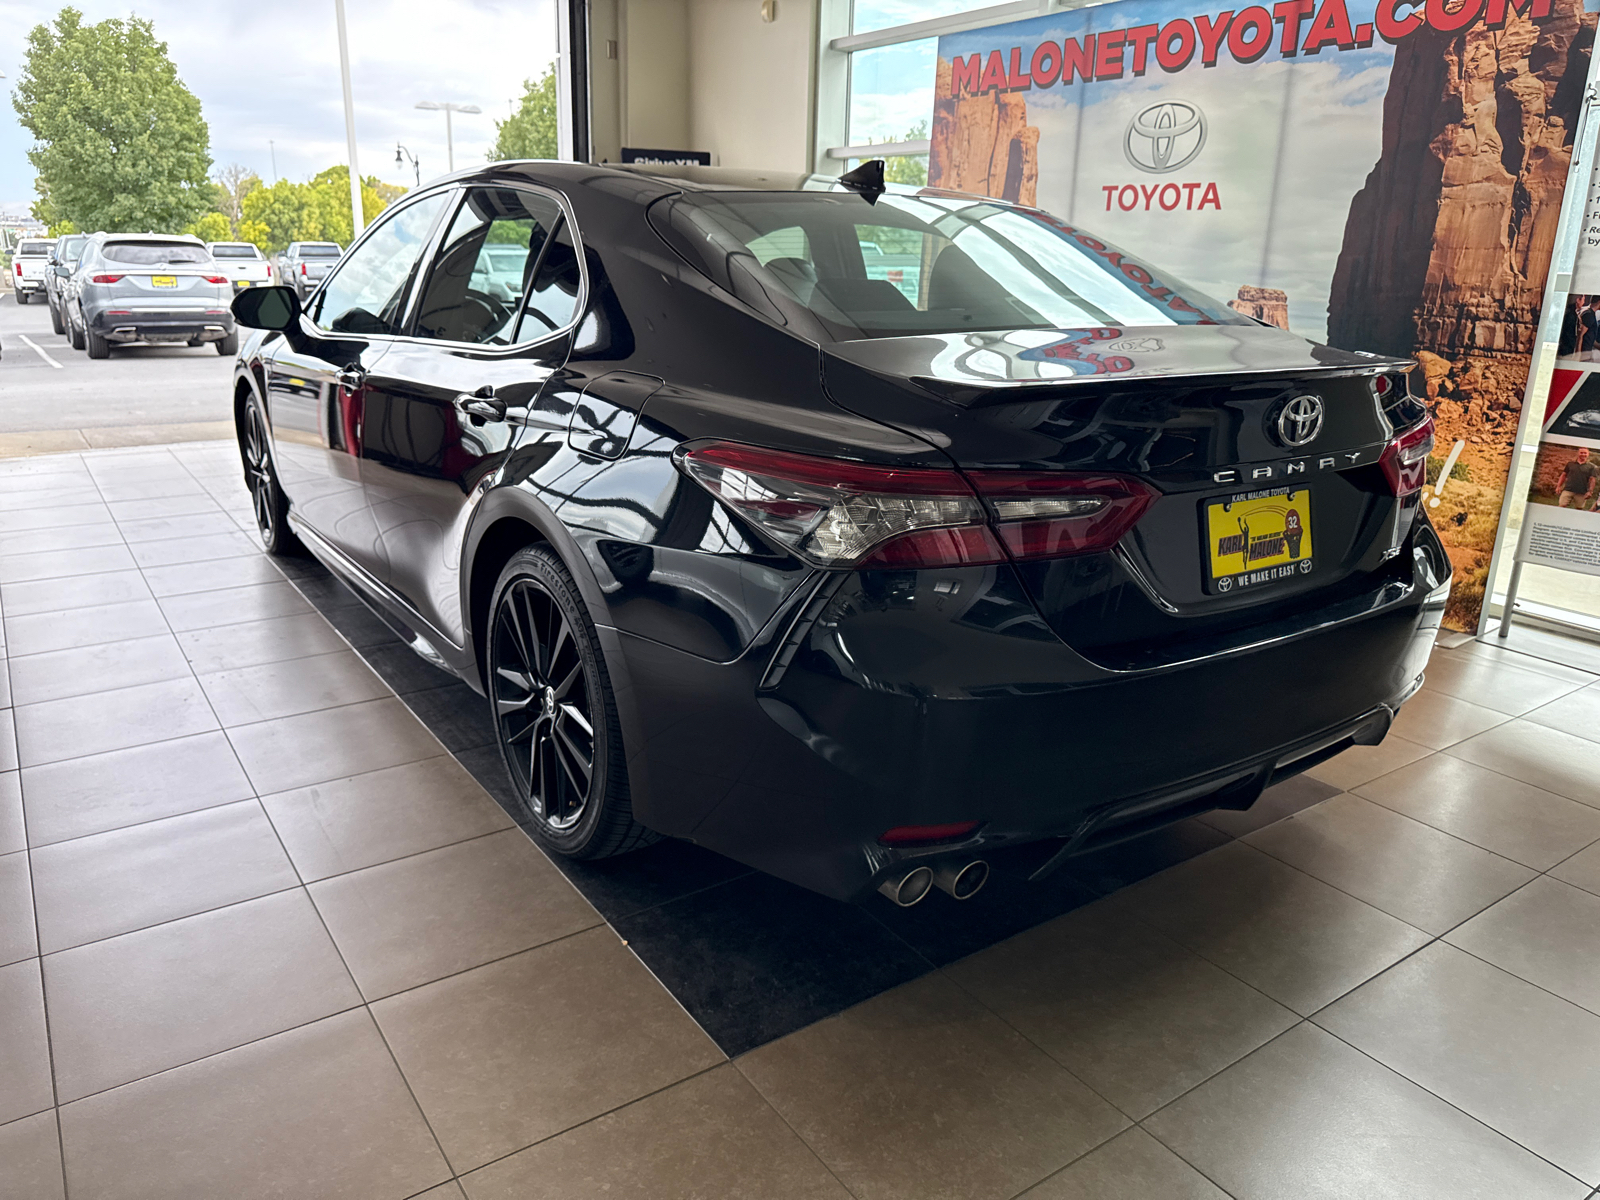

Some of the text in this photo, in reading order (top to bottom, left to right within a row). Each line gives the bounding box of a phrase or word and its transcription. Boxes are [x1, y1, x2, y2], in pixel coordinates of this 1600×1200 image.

[1101, 182, 1222, 212] TOYOTA
[1213, 452, 1361, 483] CAMRY
[1231, 486, 1290, 503] KARL MALONE TOYOTA
[1288, 515, 1298, 529] 32
[1217, 533, 1244, 557] KARL
[1248, 536, 1285, 562] MALONE
[1237, 564, 1295, 587] WE MAKE IT EASY
